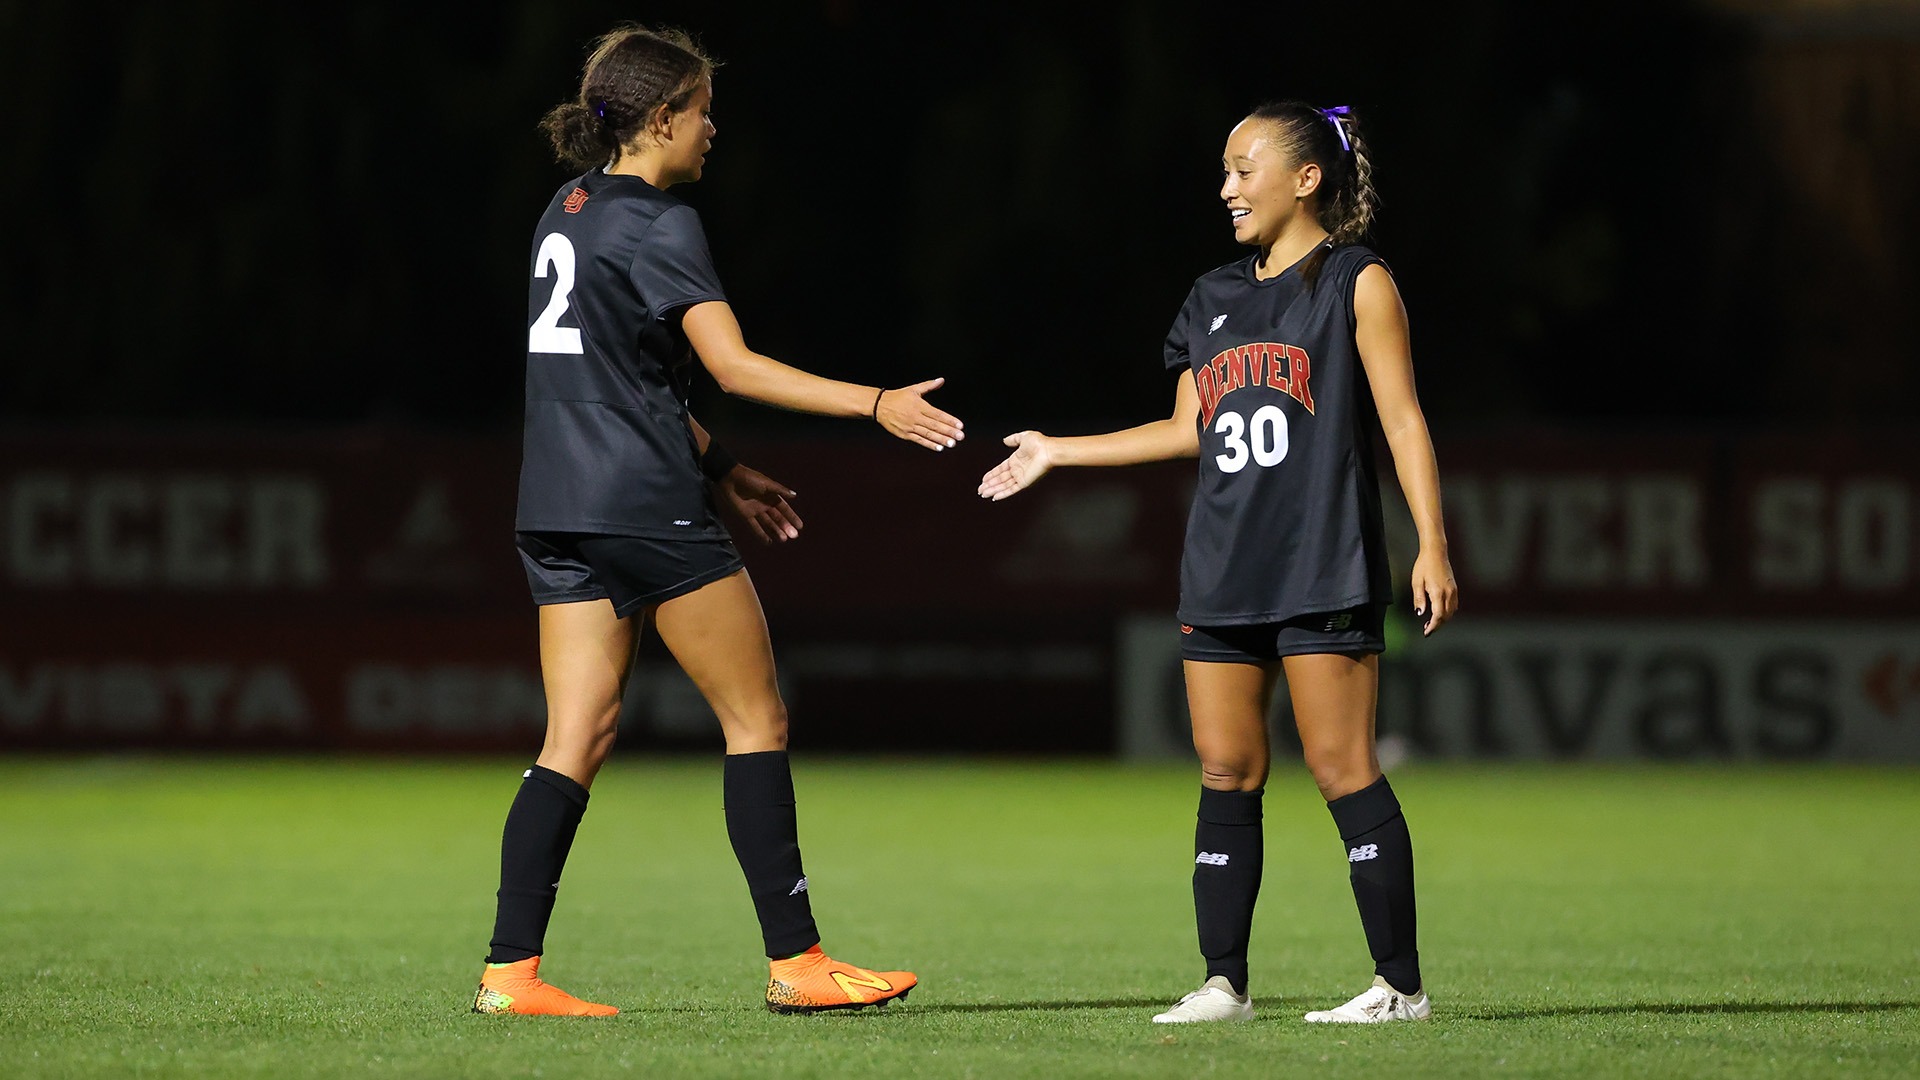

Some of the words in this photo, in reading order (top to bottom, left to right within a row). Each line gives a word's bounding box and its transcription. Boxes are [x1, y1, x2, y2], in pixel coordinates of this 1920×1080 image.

[528, 232, 585, 355] 2
[1197, 342, 1316, 433] DENVER
[1214, 405, 1290, 474] 30
